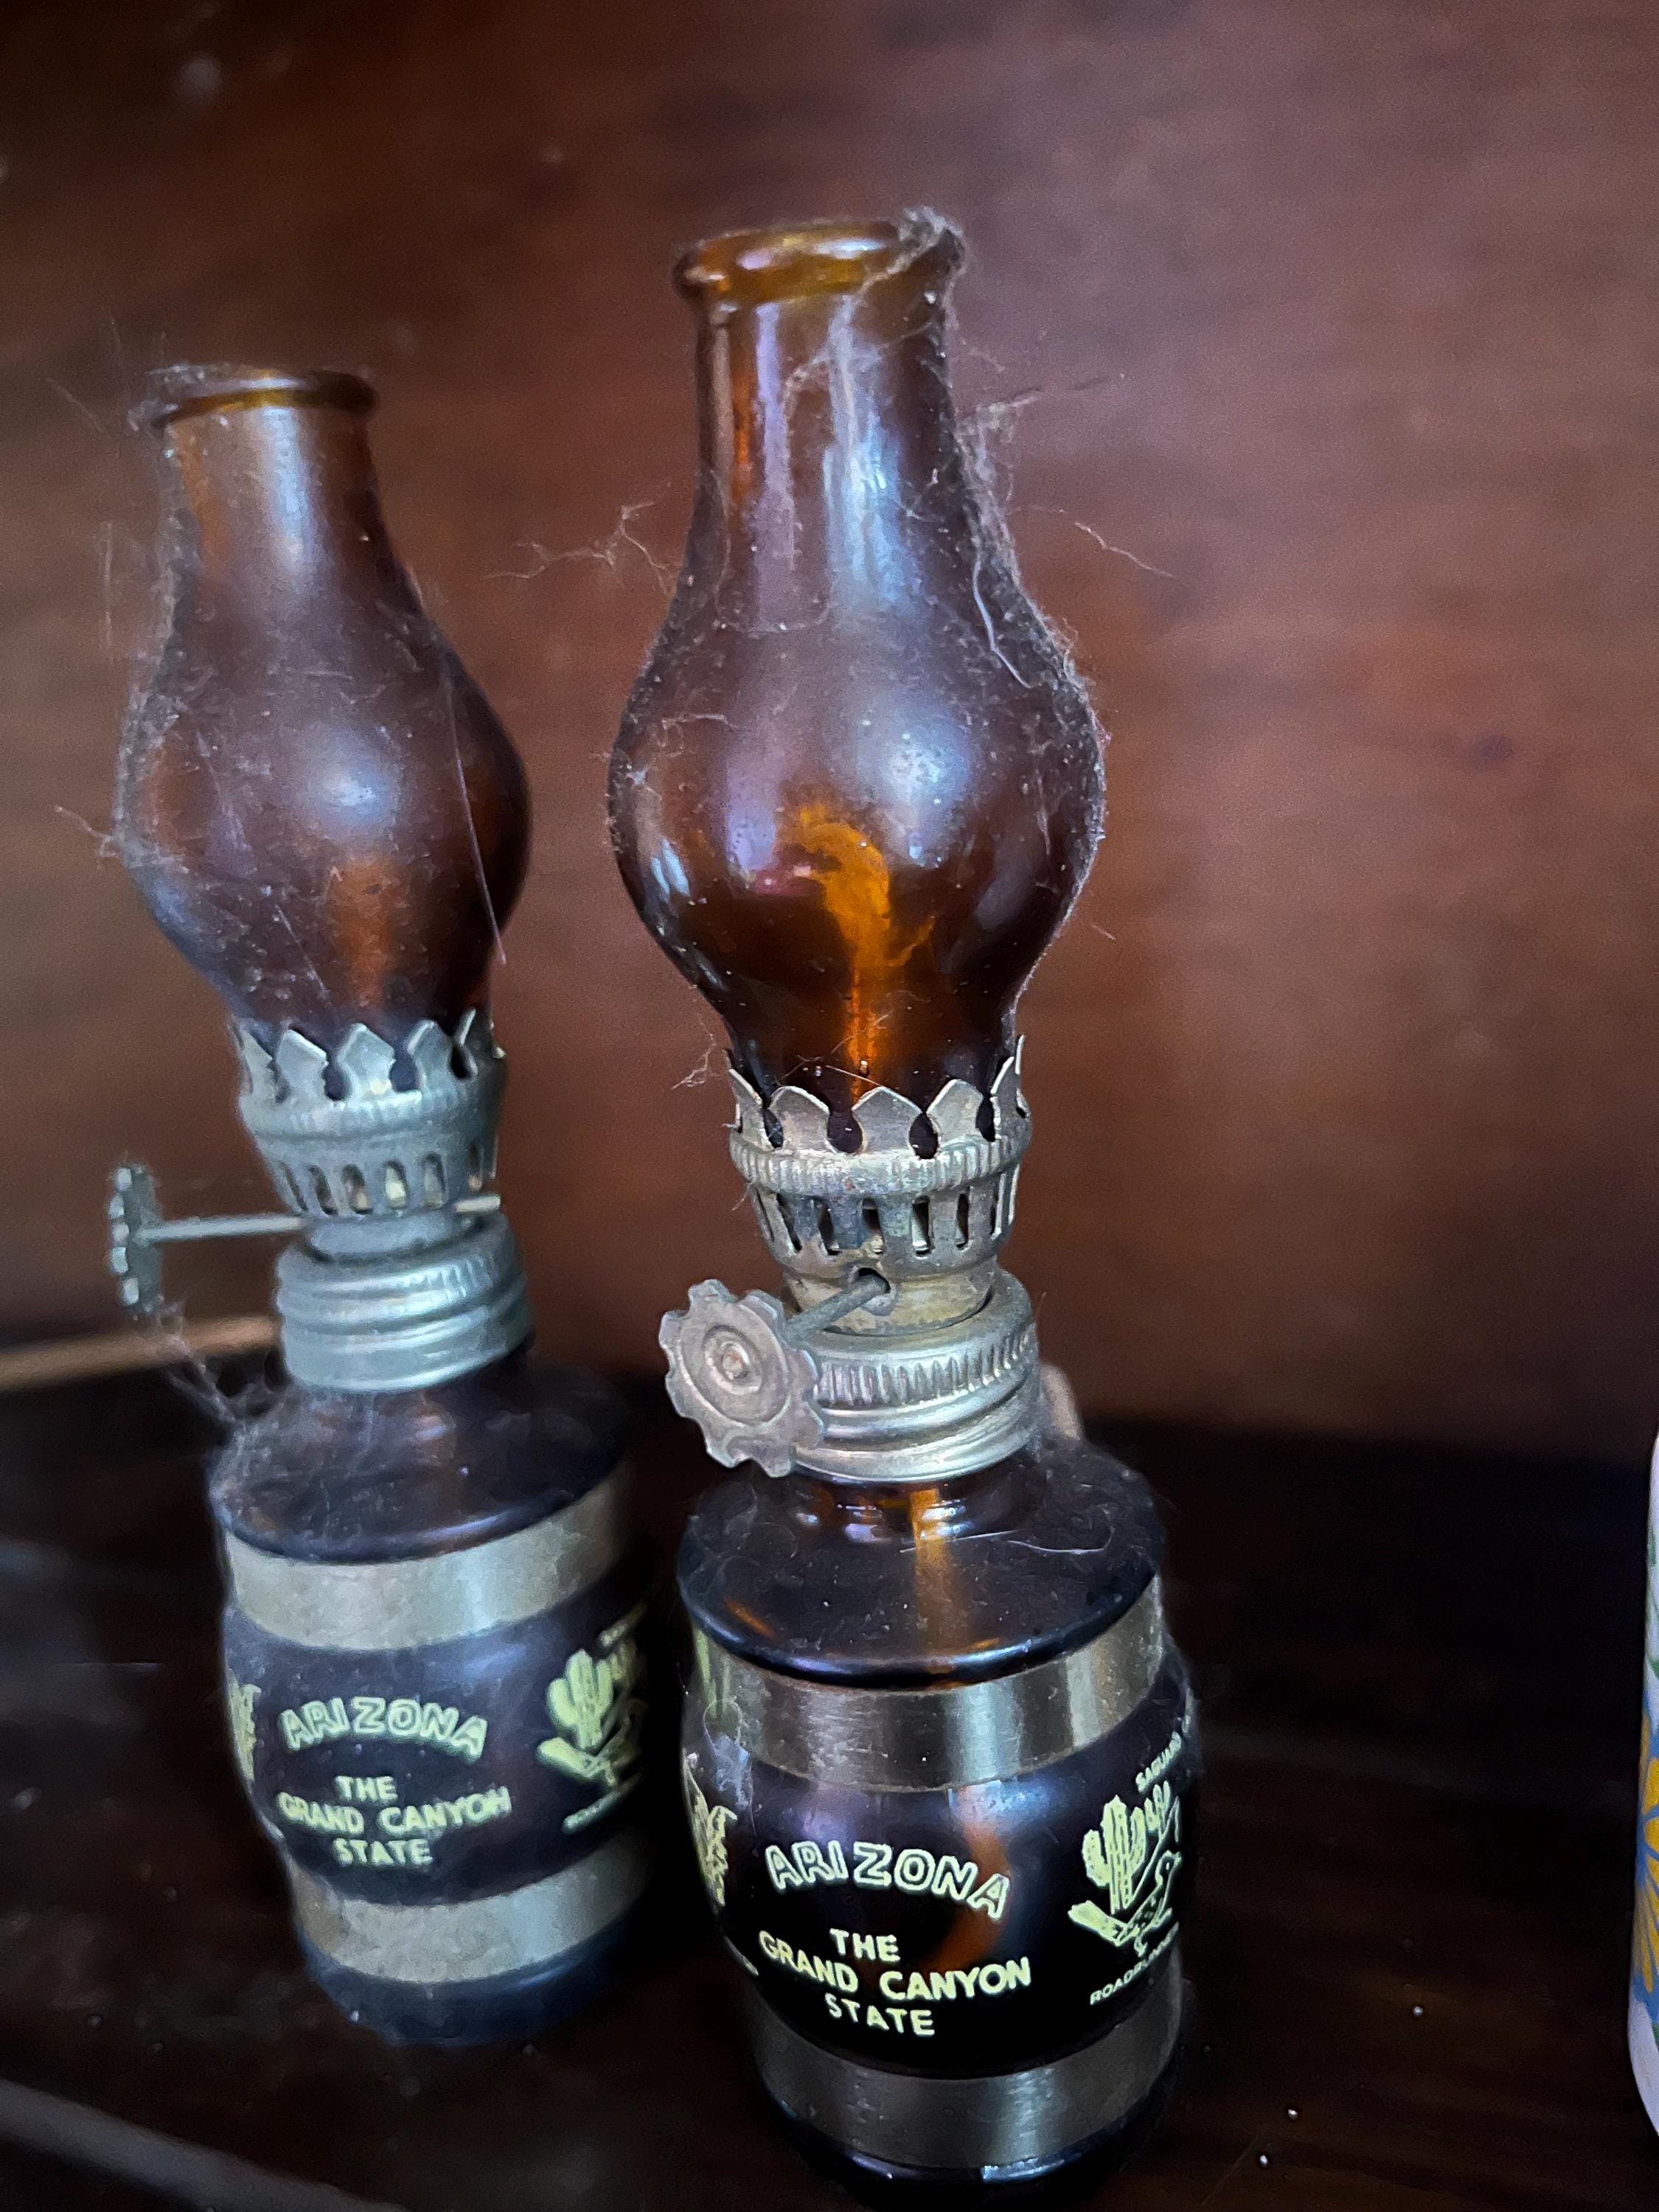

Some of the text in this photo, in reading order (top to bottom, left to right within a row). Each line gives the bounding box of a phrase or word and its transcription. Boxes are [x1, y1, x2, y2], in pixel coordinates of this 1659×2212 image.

[277, 1696, 489, 1763] ARIZONA
[277, 1792, 364, 1834] GRAND
[377, 1787, 512, 1834] CANYON
[334, 1775, 397, 1804] THE
[333, 1839, 432, 1867] STATE
[765, 1840, 1011, 1920] ARIZONA
[758, 1930, 1032, 2001] GRAND CANYON
[830, 1928, 900, 1961] THE
[826, 1993, 935, 2037] STATE
